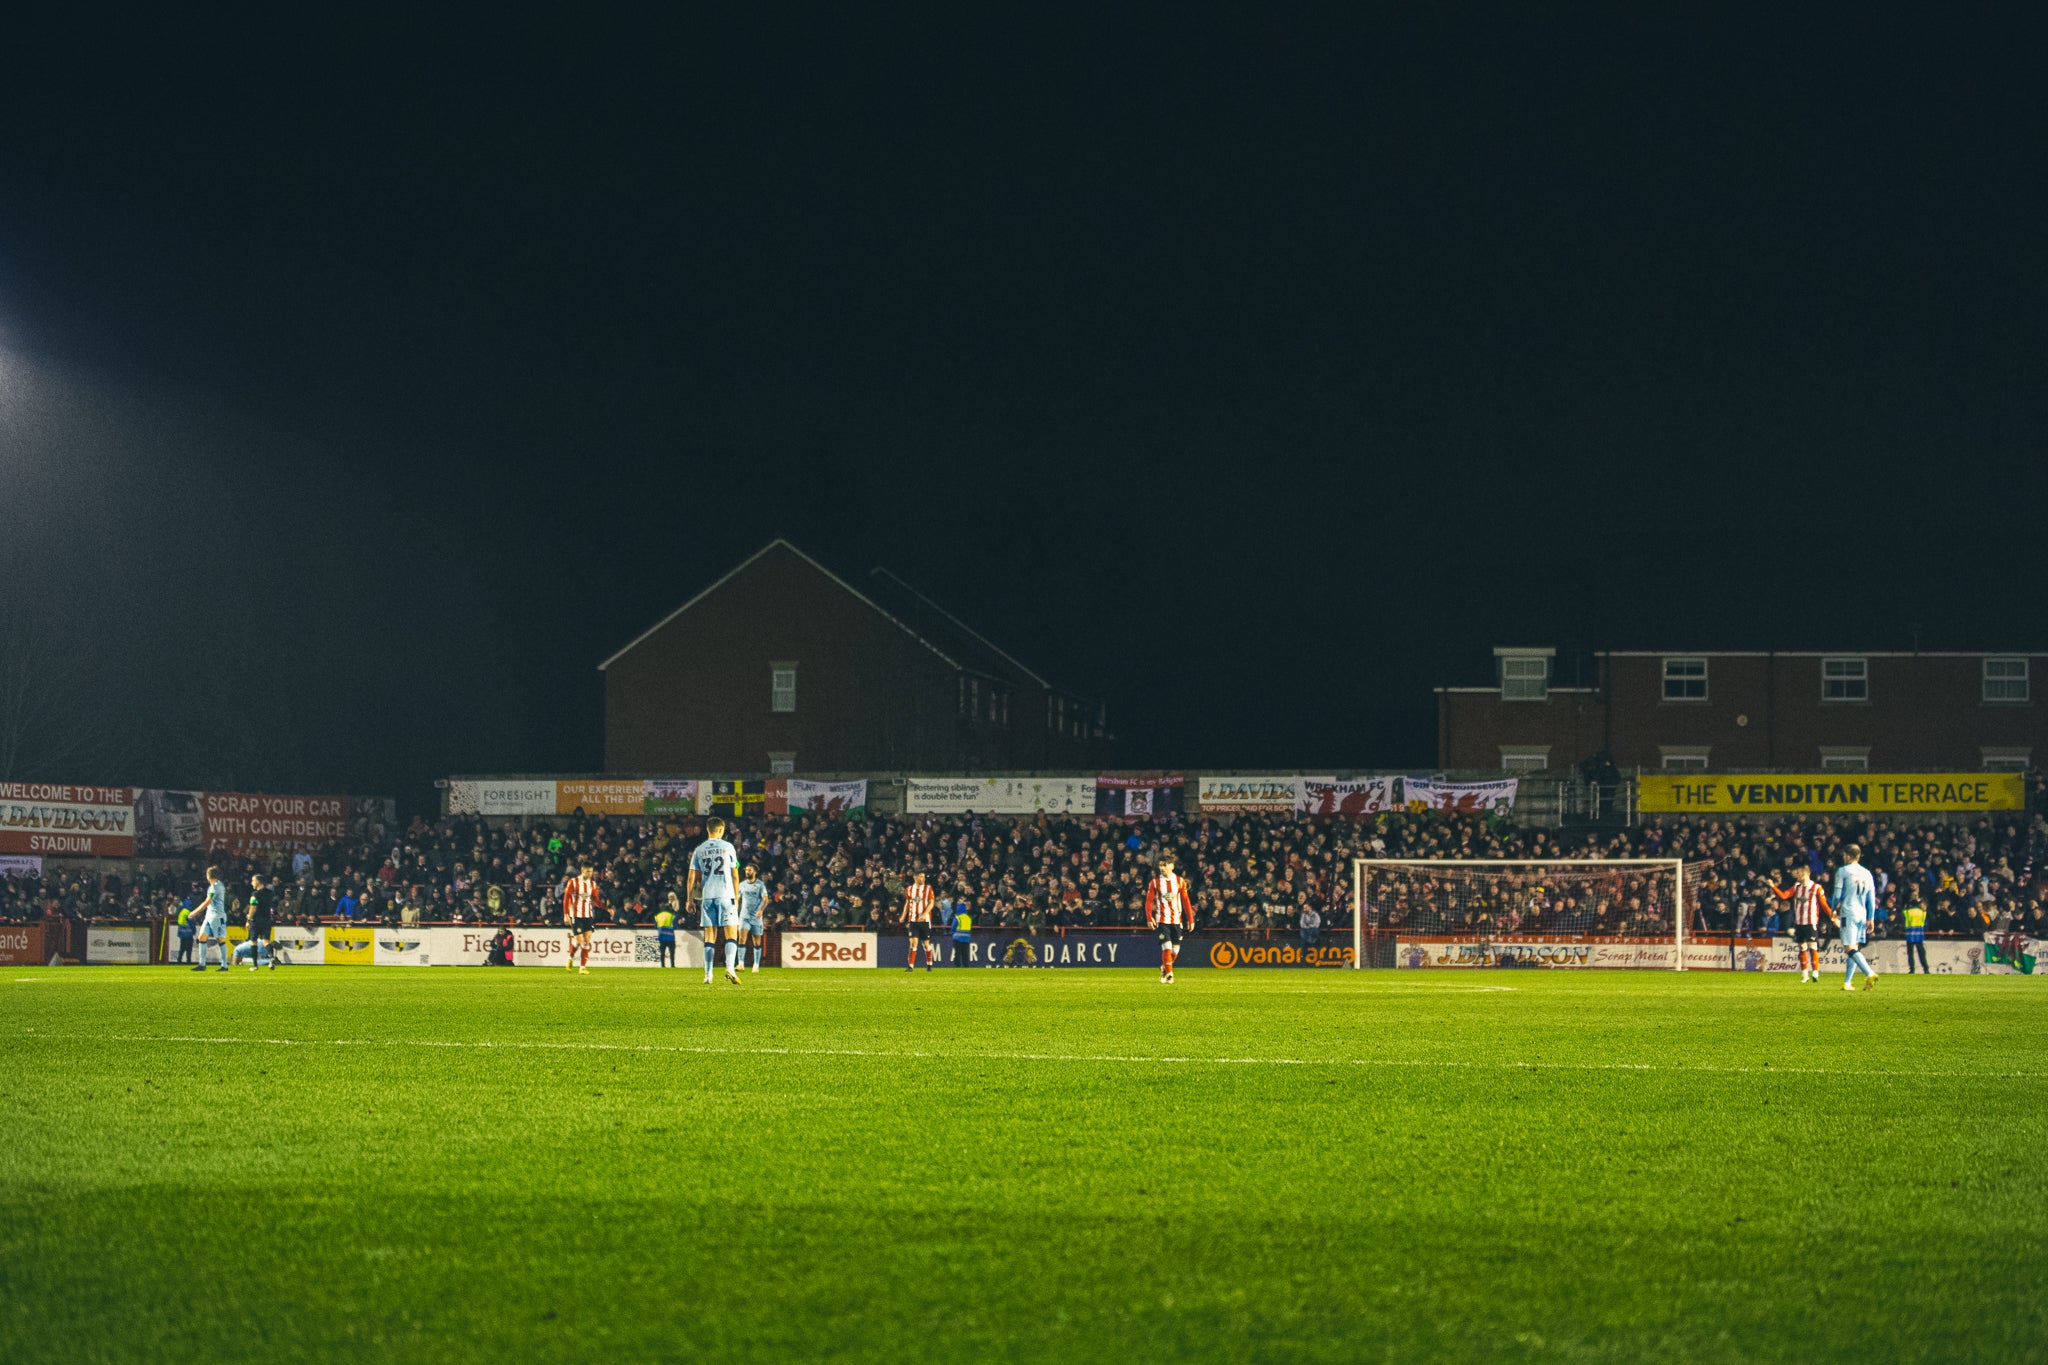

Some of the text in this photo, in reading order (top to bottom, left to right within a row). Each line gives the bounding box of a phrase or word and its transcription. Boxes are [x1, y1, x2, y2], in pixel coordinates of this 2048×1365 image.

[0, 784, 123, 803] WELCOME TO THE
[484, 791, 550, 800] FORESIGHT
[563, 785, 585, 794] OUR
[950, 784, 980, 794] siblings
[1304, 780, 1386, 794] WREXHAM FC
[1672, 782, 1989, 804] THE VENDITAN TERRACE
[581, 795, 601, 804] ALL
[604, 795, 625, 804] THE
[923, 792, 948, 800] double
[949, 792, 962, 800] the
[207, 796, 341, 816] SCRAP YOUR CAR
[1202, 804, 1216, 812] TOP
[1216, 804, 1241, 812] PRICES
[208, 817, 346, 837] WITH CONFIDENCE
[30, 835, 92, 852] STADIUM
[702, 856, 725, 877] 32
[0, 930, 28, 950] ancé
[463, 934, 561, 957] Fieings
[791, 942, 867, 962] 32Red
[1045, 943, 1118, 964] DARCY
[1594, 949, 1633, 964] Scrap
[1633, 950, 1669, 962] Metal
[1670, 951, 1728, 963] ocessors
[1766, 962, 1797, 972] 32Red
